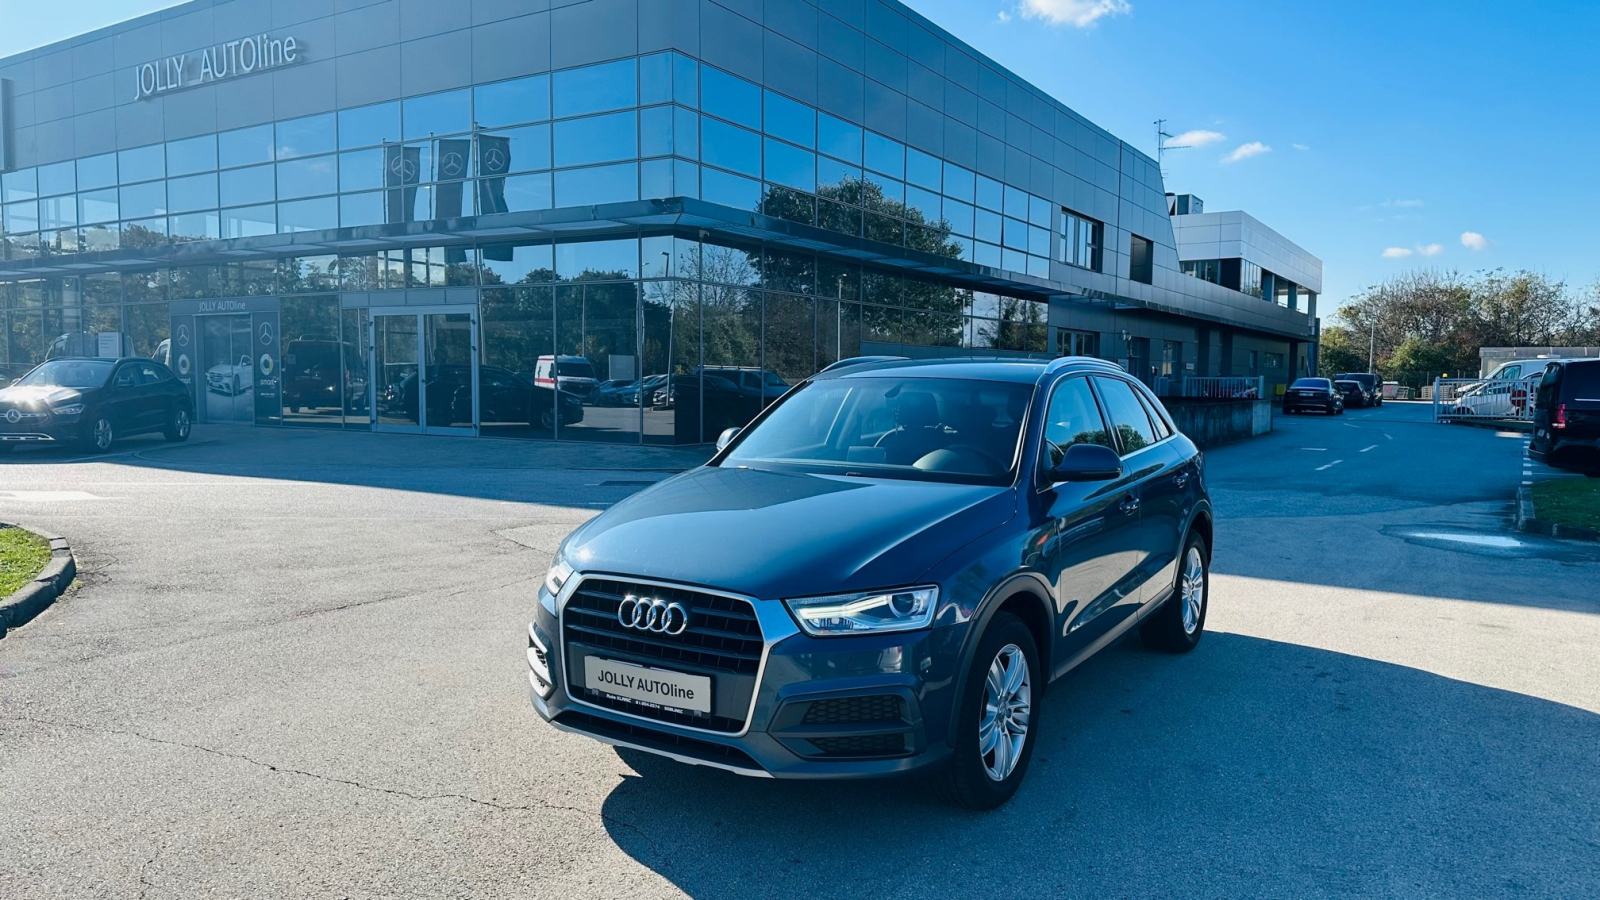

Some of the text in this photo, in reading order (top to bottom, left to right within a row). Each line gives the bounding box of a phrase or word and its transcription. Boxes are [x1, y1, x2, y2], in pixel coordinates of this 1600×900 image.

[134, 33, 297, 100] JOLLY AUTOline
[199, 300, 217, 313] JOLLY
[598, 669, 635, 689] JOLLY
[637, 678, 695, 700] AUTOline
